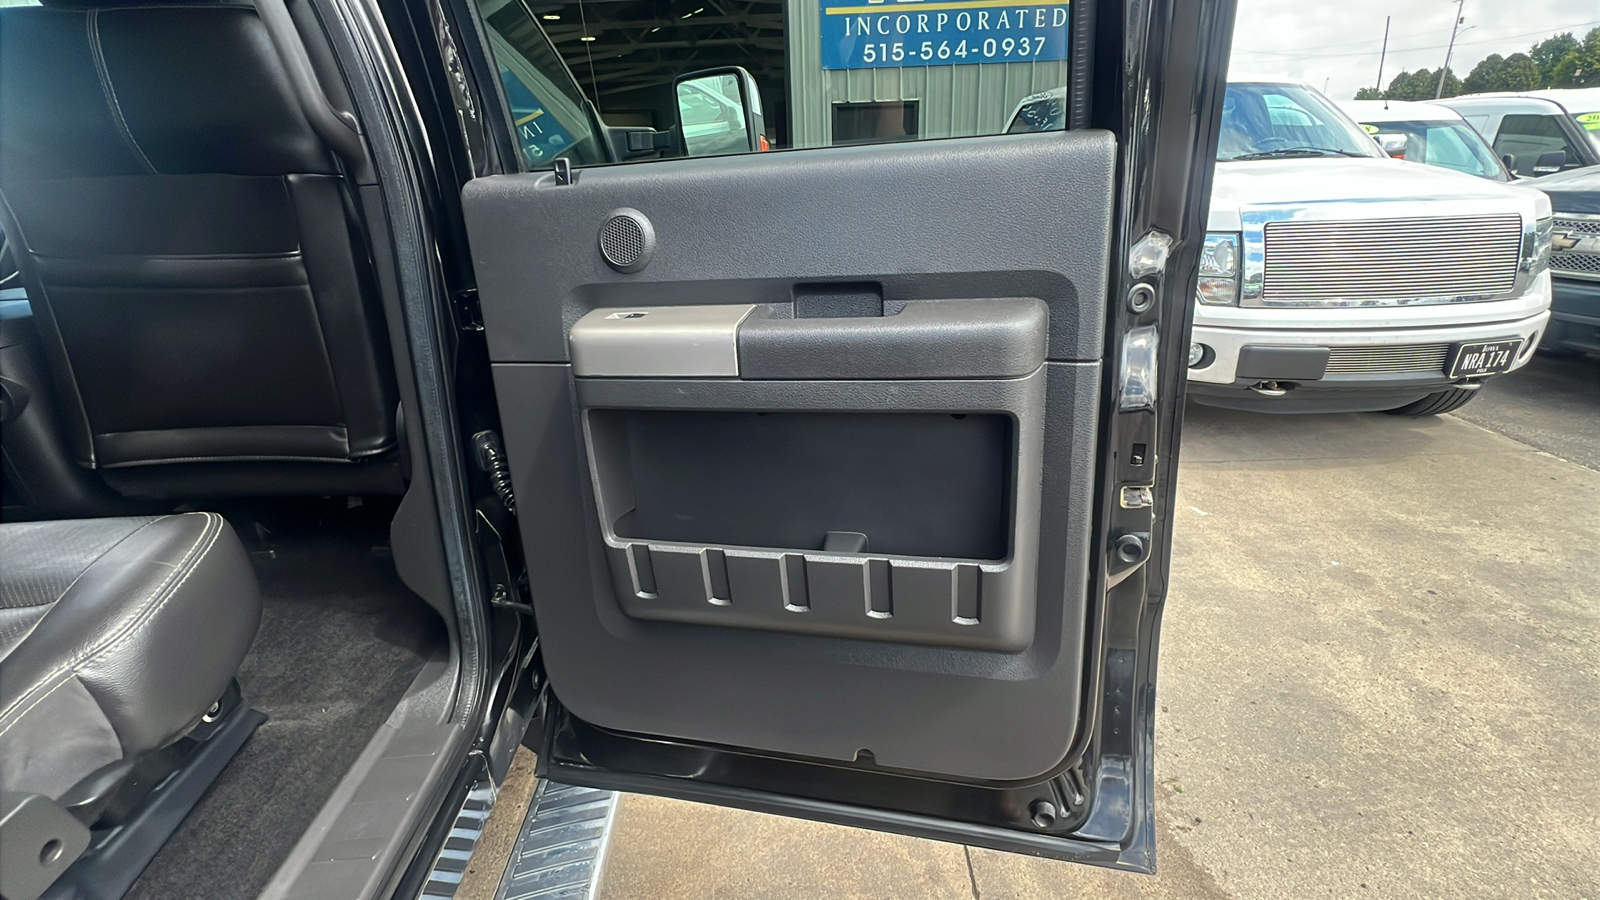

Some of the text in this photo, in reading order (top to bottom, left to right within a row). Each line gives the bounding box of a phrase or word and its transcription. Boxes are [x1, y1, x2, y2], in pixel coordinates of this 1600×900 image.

[844, 8, 1067, 37] INCORPORATED
[863, 36, 1046, 63] 515-564-0937
[1461, 350, 1510, 370] NRA 174
